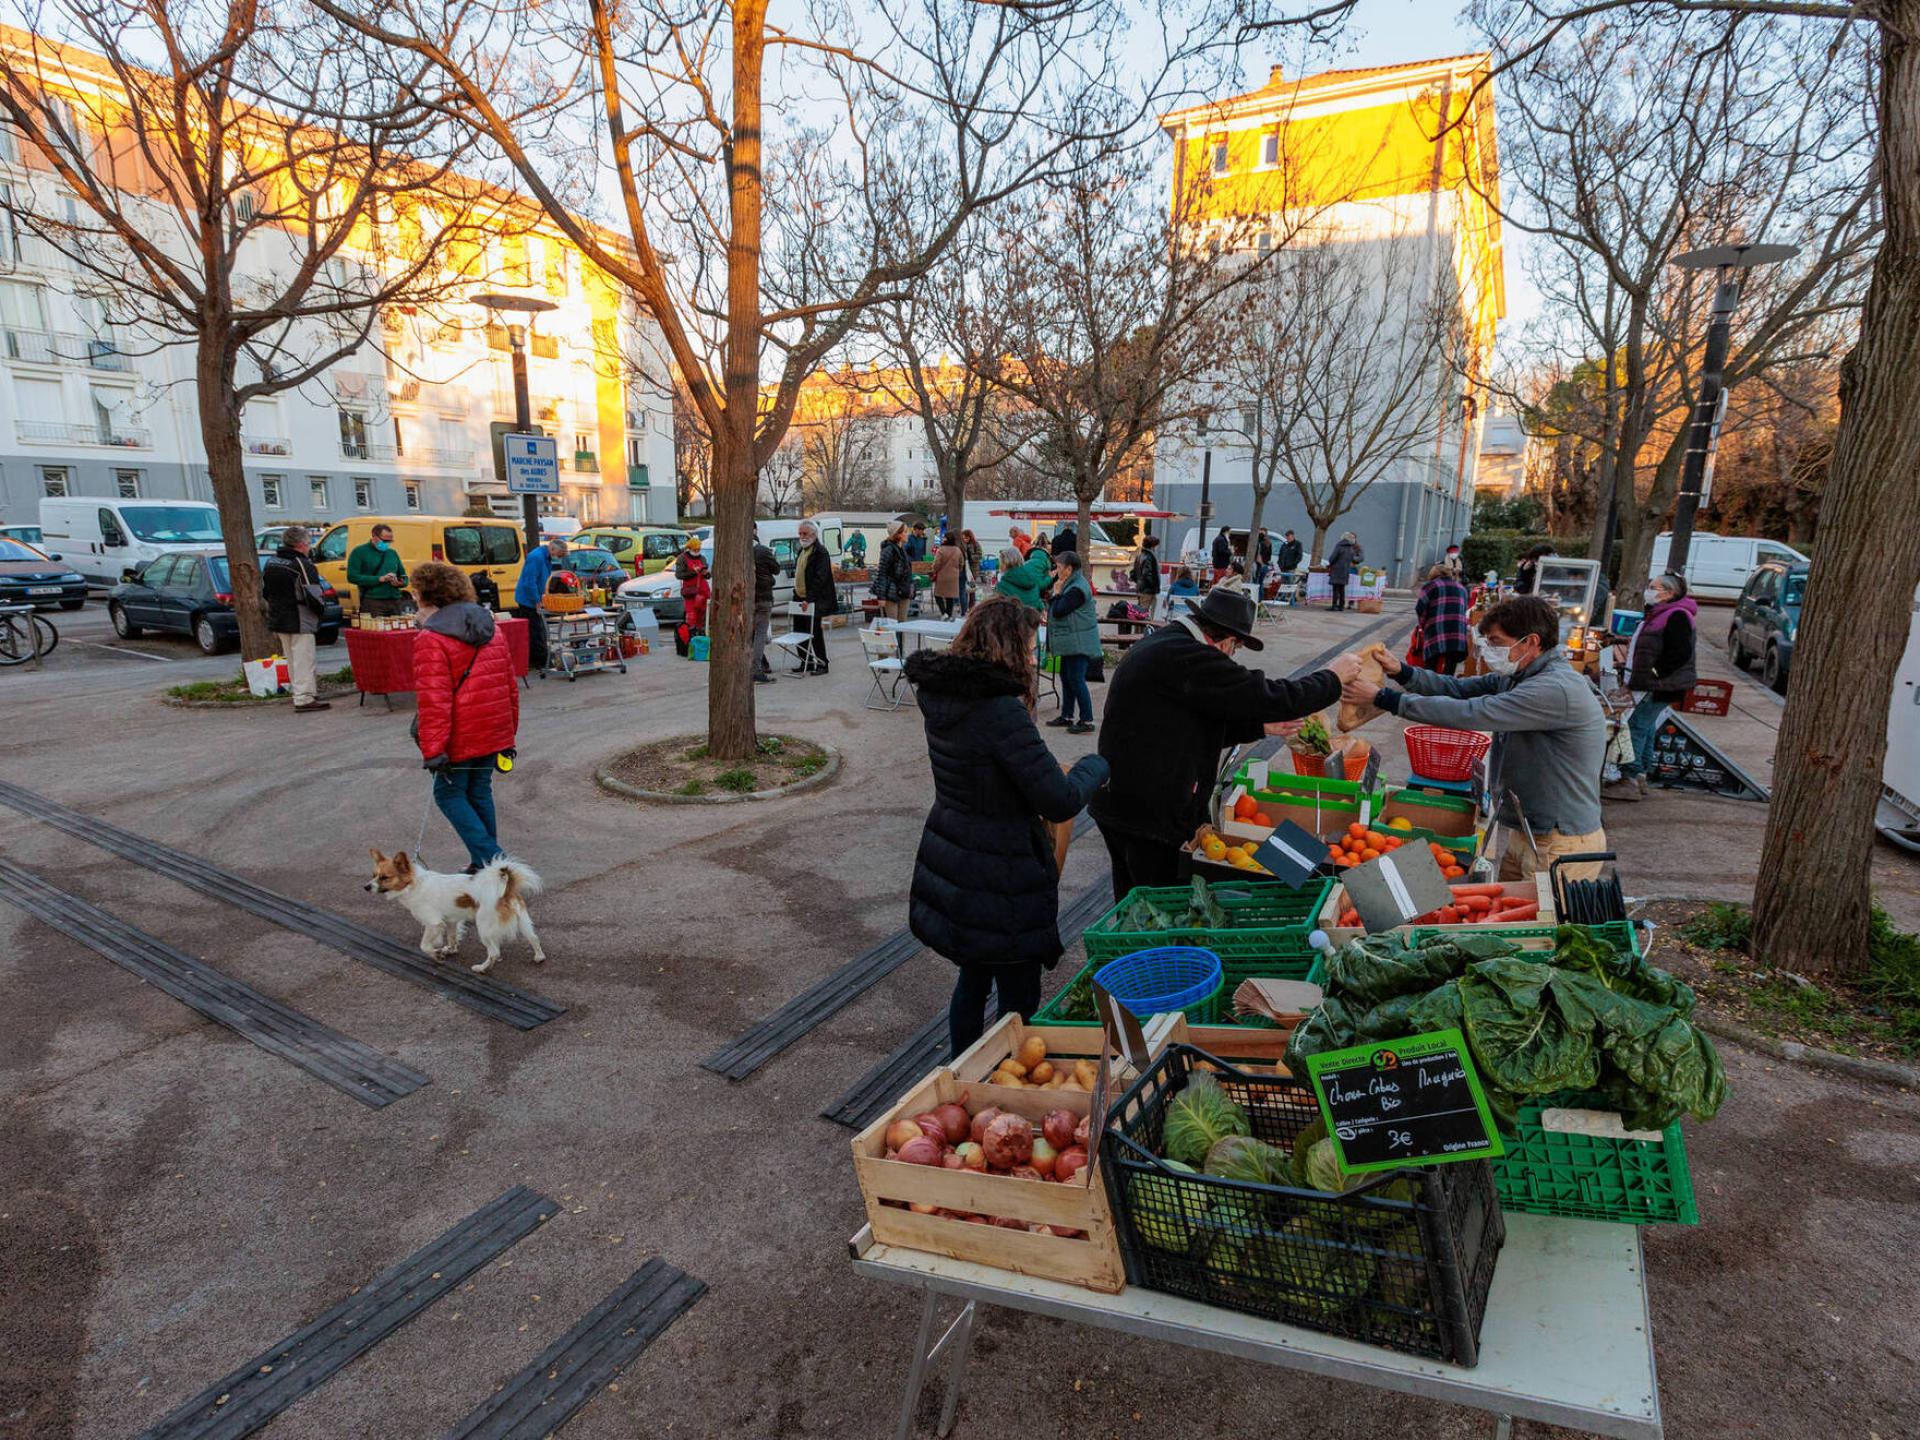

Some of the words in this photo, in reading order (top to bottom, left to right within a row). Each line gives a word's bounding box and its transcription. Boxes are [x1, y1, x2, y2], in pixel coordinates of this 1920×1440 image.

[1398, 1044, 1425, 1055] Produit
[1427, 1040, 1448, 1049] Local
[1340, 1056, 1366, 1065] Directe
[1380, 1095, 1402, 1112] Bio
[1387, 1130, 1414, 1150] 3€
[1443, 1143, 1467, 1152] Origine
[1467, 1140, 1489, 1149] France
